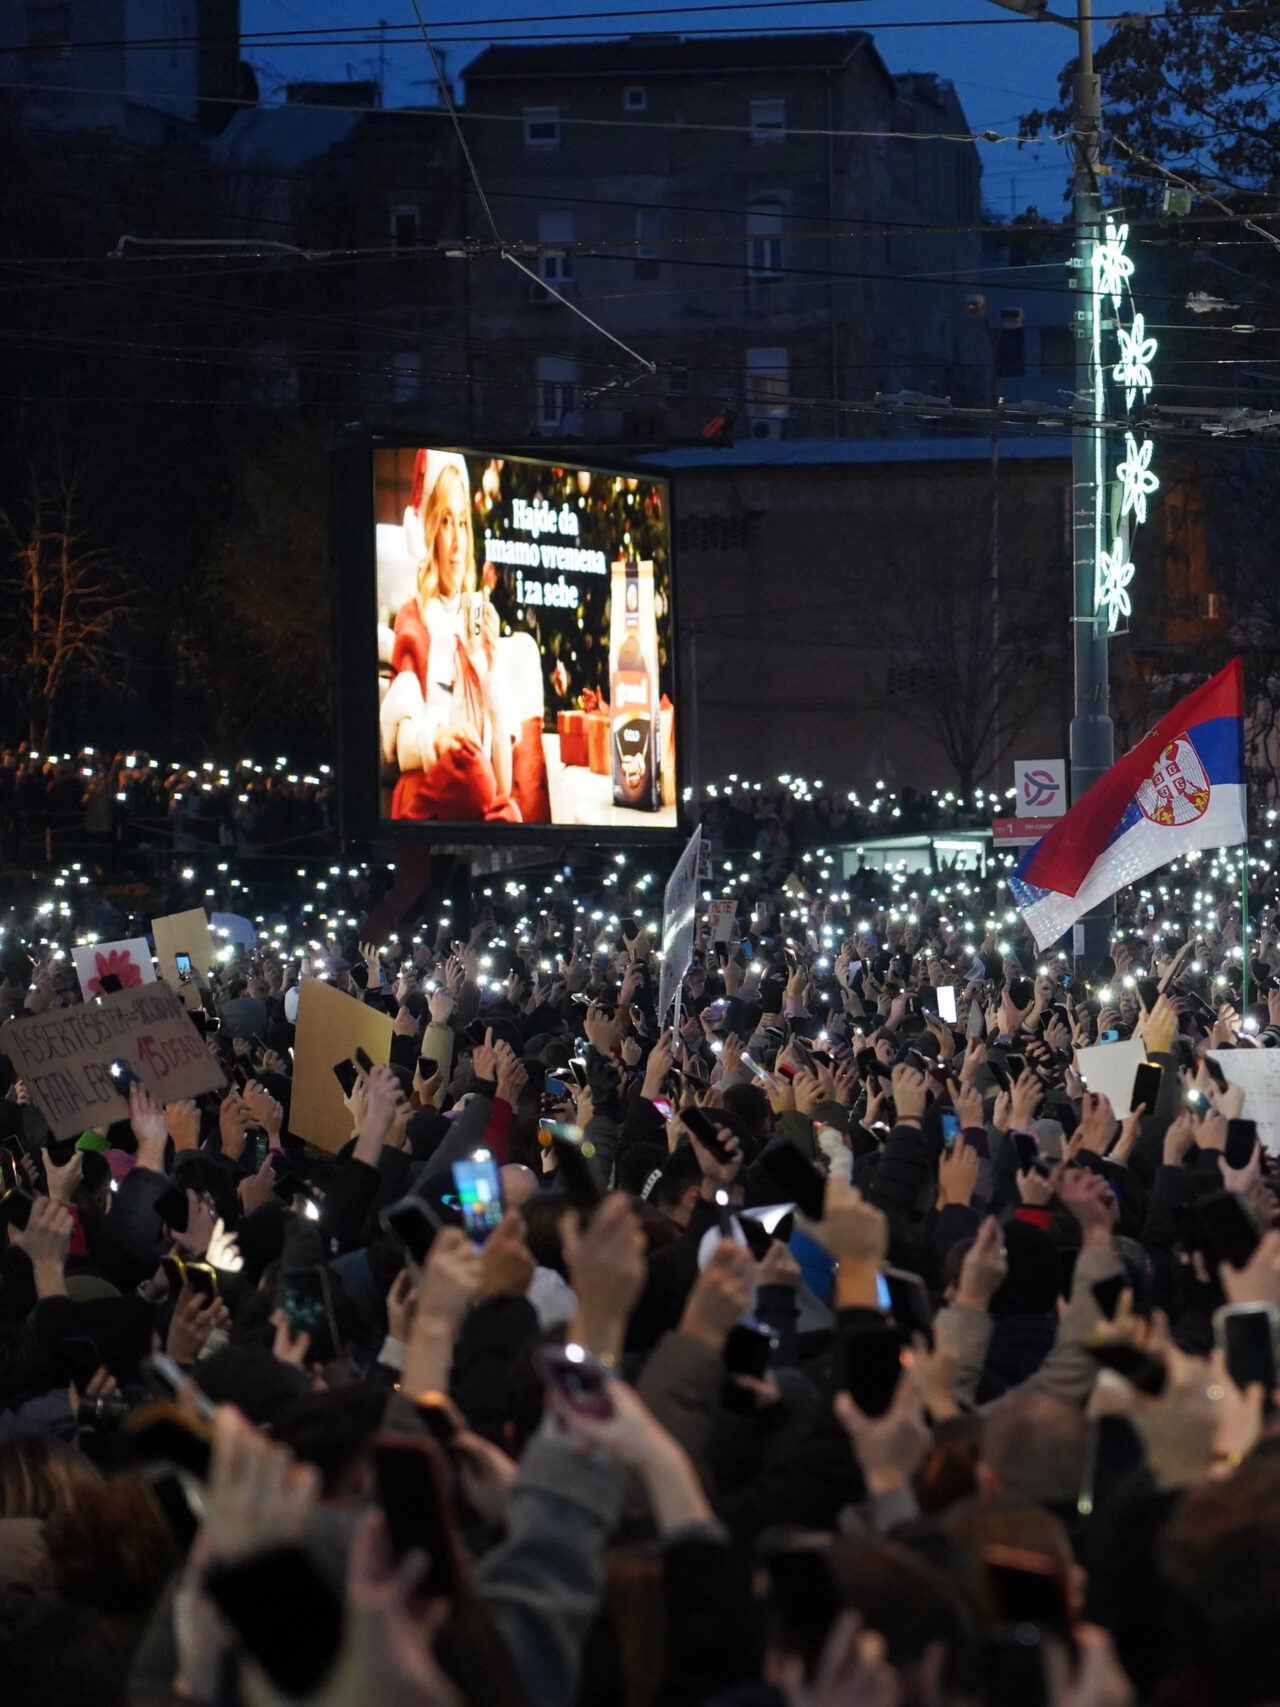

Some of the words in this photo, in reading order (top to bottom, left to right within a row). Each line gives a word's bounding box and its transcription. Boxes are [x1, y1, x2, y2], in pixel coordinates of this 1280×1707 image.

[512, 498, 558, 538] Hajde
[558, 502, 579, 536] da
[485, 528, 540, 567] imamo
[540, 545, 607, 574] vremena
[516, 569, 523, 603] i
[524, 580, 543, 605] za
[544, 575, 579, 609] sebe
[136, 1035, 169, 1079] 15
